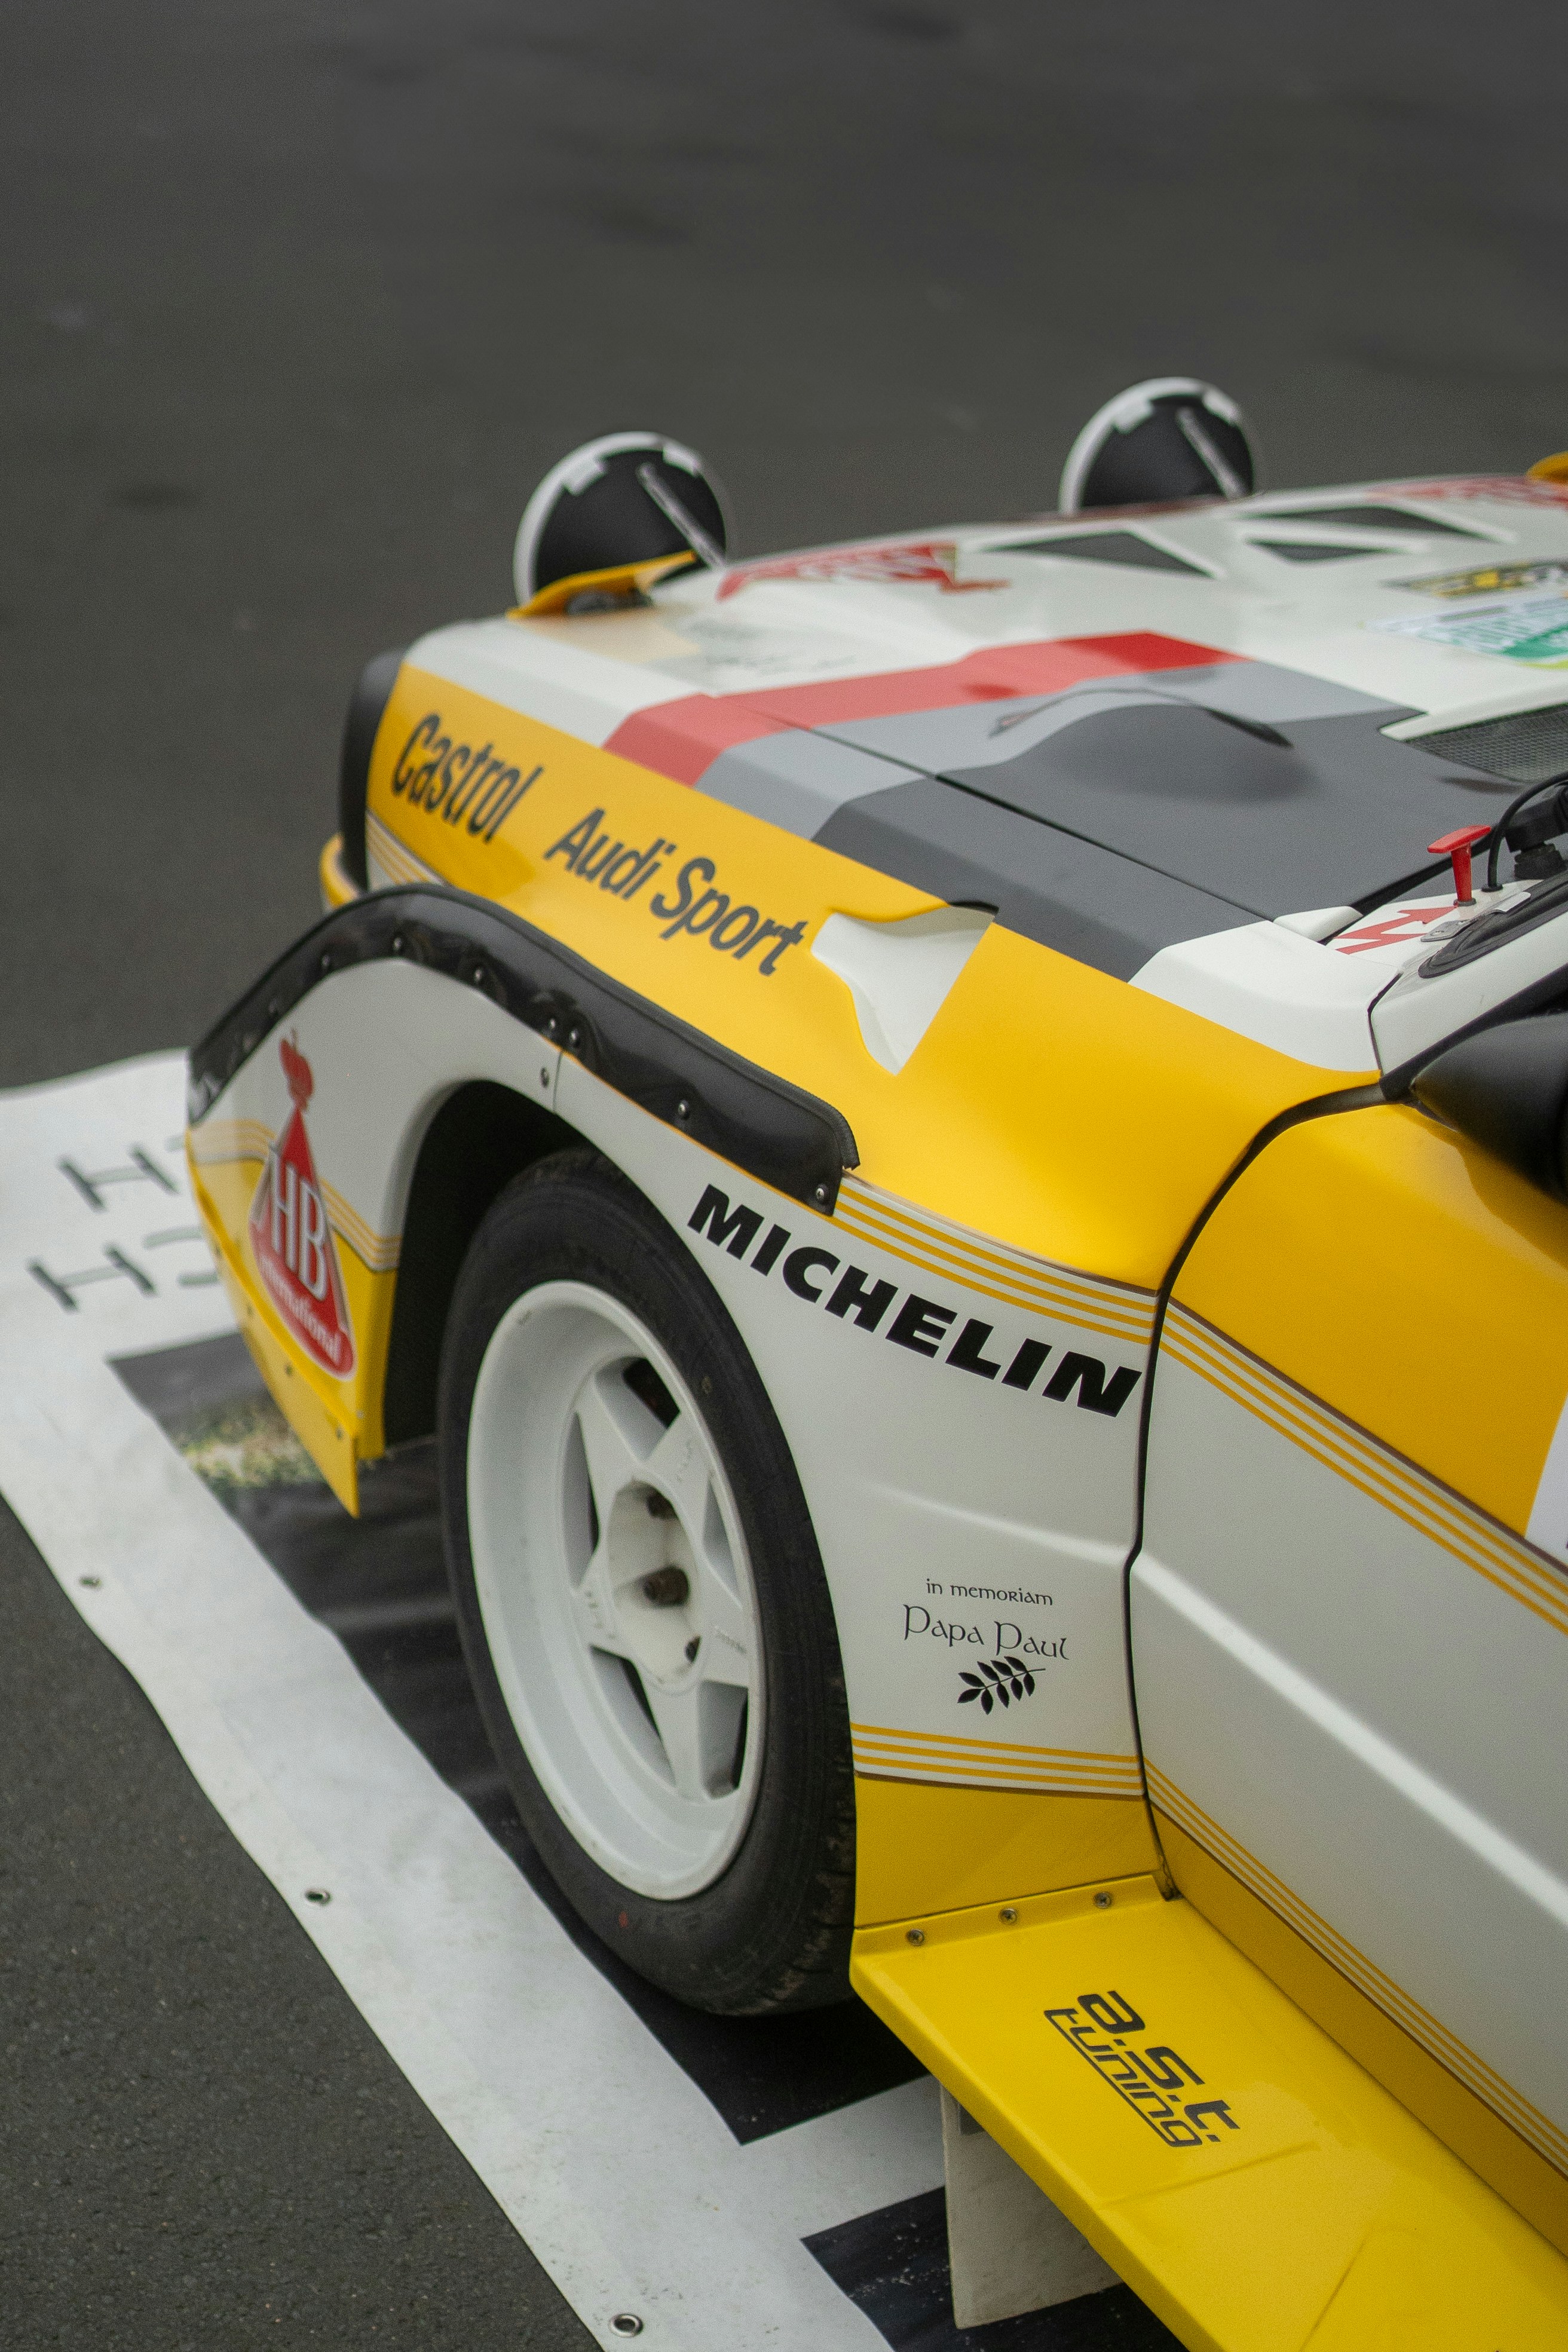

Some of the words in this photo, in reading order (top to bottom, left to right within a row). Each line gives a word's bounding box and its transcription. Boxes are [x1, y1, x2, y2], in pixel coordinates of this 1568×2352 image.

[391, 713, 543, 843] Castrol
[543, 807, 676, 901] Audi
[649, 856, 809, 976] Sport
[268, 1139, 329, 1301] HB
[687, 1183, 1142, 1417] MICHELIN
[902, 1604, 985, 1647] Papa
[993, 1621, 1070, 1661] Paul
[926, 1578, 943, 1595] in
[950, 1584, 1054, 1606] memoriam
[1043, 2008, 1203, 2148] tuning
